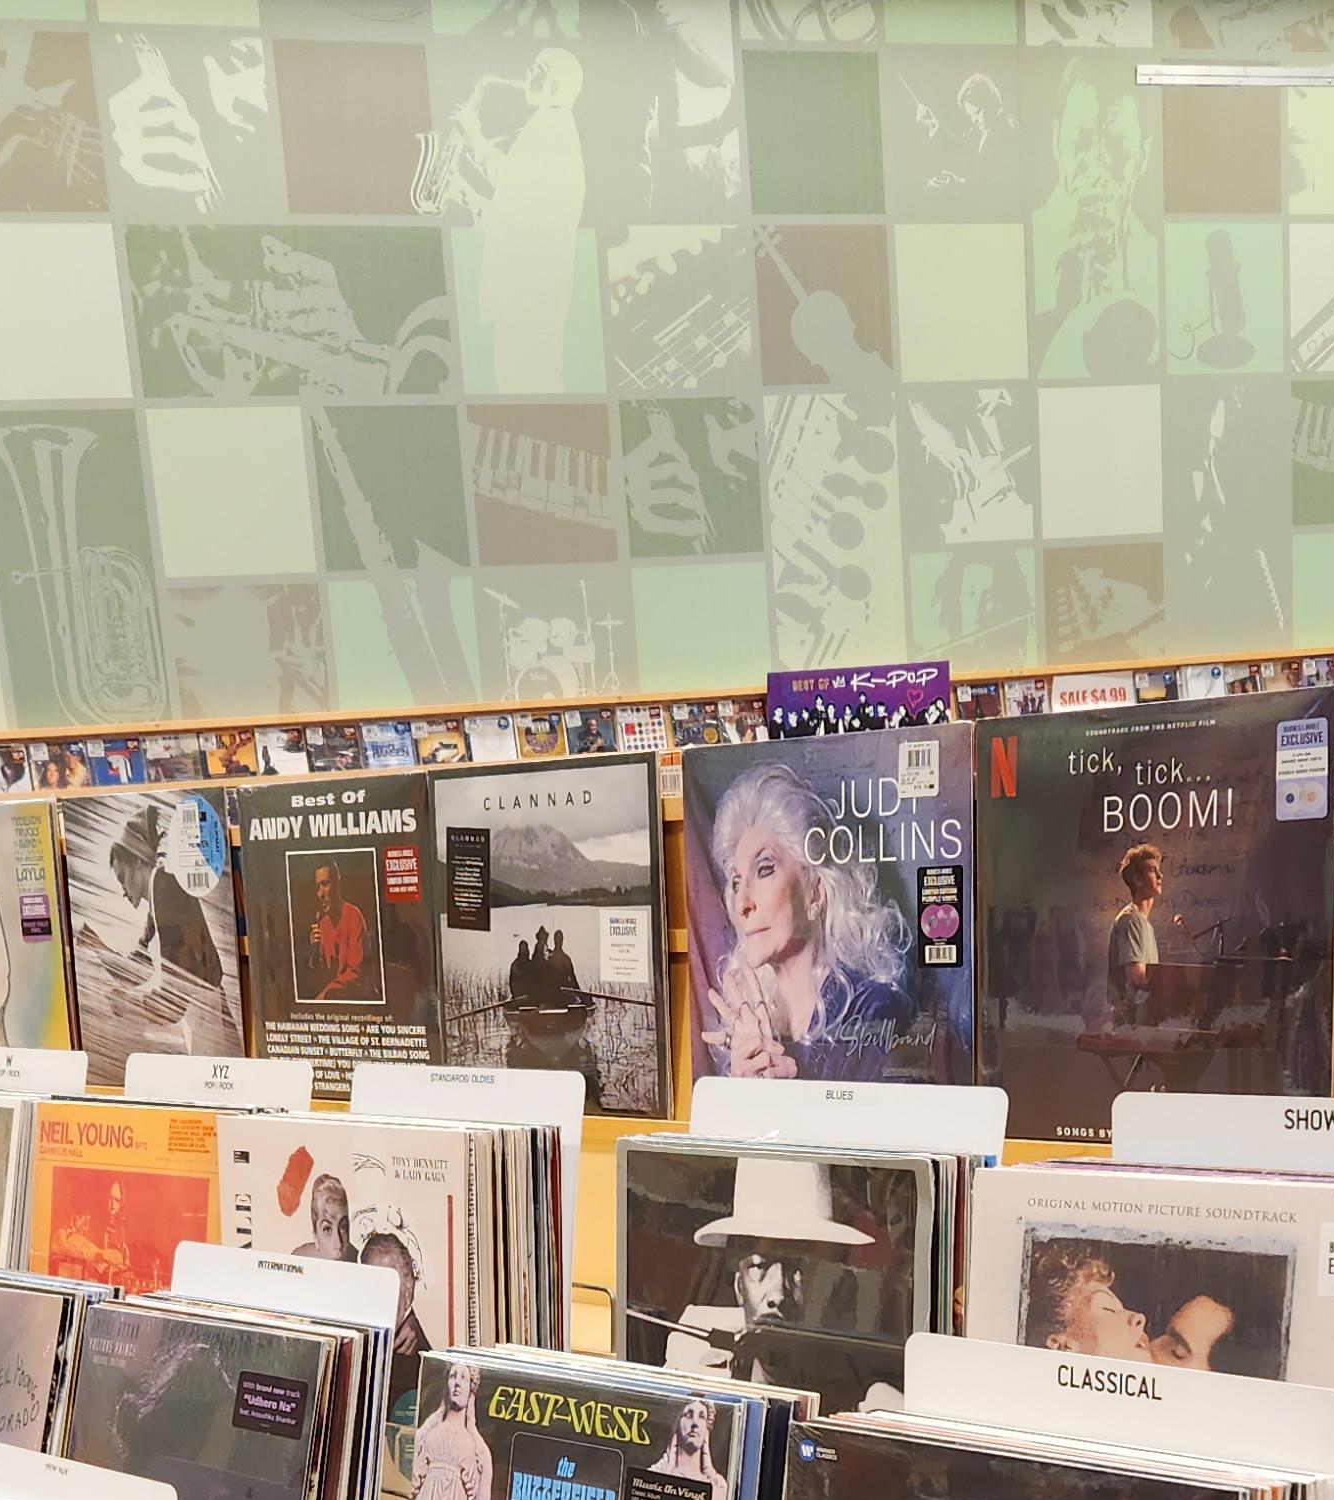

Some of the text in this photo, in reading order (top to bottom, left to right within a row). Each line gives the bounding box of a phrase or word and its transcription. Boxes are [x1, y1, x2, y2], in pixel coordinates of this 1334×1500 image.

[792, 668, 938, 692] BEST OF K-POP
[1059, 686, 1127, 707] SALE $4.99
[1198, 719, 1216, 729] FILM
[1280, 730, 1325, 748] EXCLUSIVE
[1067, 746, 1124, 777] tick,
[290, 789, 366, 808] Best Of
[482, 789, 593, 812] CLANNAD
[1102, 788, 1235, 834] BOOM!
[249, 808, 417, 841] ANDY WILLIAMS
[804, 818, 963, 866] COLLINS
[385, 857, 418, 872] EXCLUSIVE
[923, 875, 956, 887] EXCLUSIVE
[609, 925, 638, 938] EXCLUSIVE
[351, 1014, 384, 1024] recordings
[310, 1023, 427, 1035] WEDDING SONG ARE YOU SINCERE
[839, 1014, 939, 1059] Spellbound
[290, 1034, 428, 1048] STREET THE VILLAGE OF BERNADETTE
[267, 1044, 430, 1061] CANADIAN SUNSET BUTTERFLY THE BILBAO SONG
[210, 1064, 231, 1080] XYZ
[471, 1073, 495, 1085] OLDIES
[314, 1081, 351, 1092] STRANGERS
[825, 1089, 854, 1101] BLUES
[39, 1119, 74, 1147] NEIL
[77, 1123, 135, 1151] YOUNG
[1056, 1126, 1113, 1140] SONGS BY
[67, 1148, 84, 1158] HALL
[391, 1155, 450, 1171] TONY BENNETT
[394, 1169, 447, 1183] & LADY GAGA
[1027, 1197, 1299, 1224] ORIGINAL MOTION PICTURE SOUNDTRACK
[257, 1259, 305, 1276] INTERNATIONAL
[1057, 1364, 1163, 1402] CLASSICAL
[487, 1385, 652, 1446] EAST-WEST
[556, 1454, 577, 1479] the
[632, 1477, 663, 1492] Music
